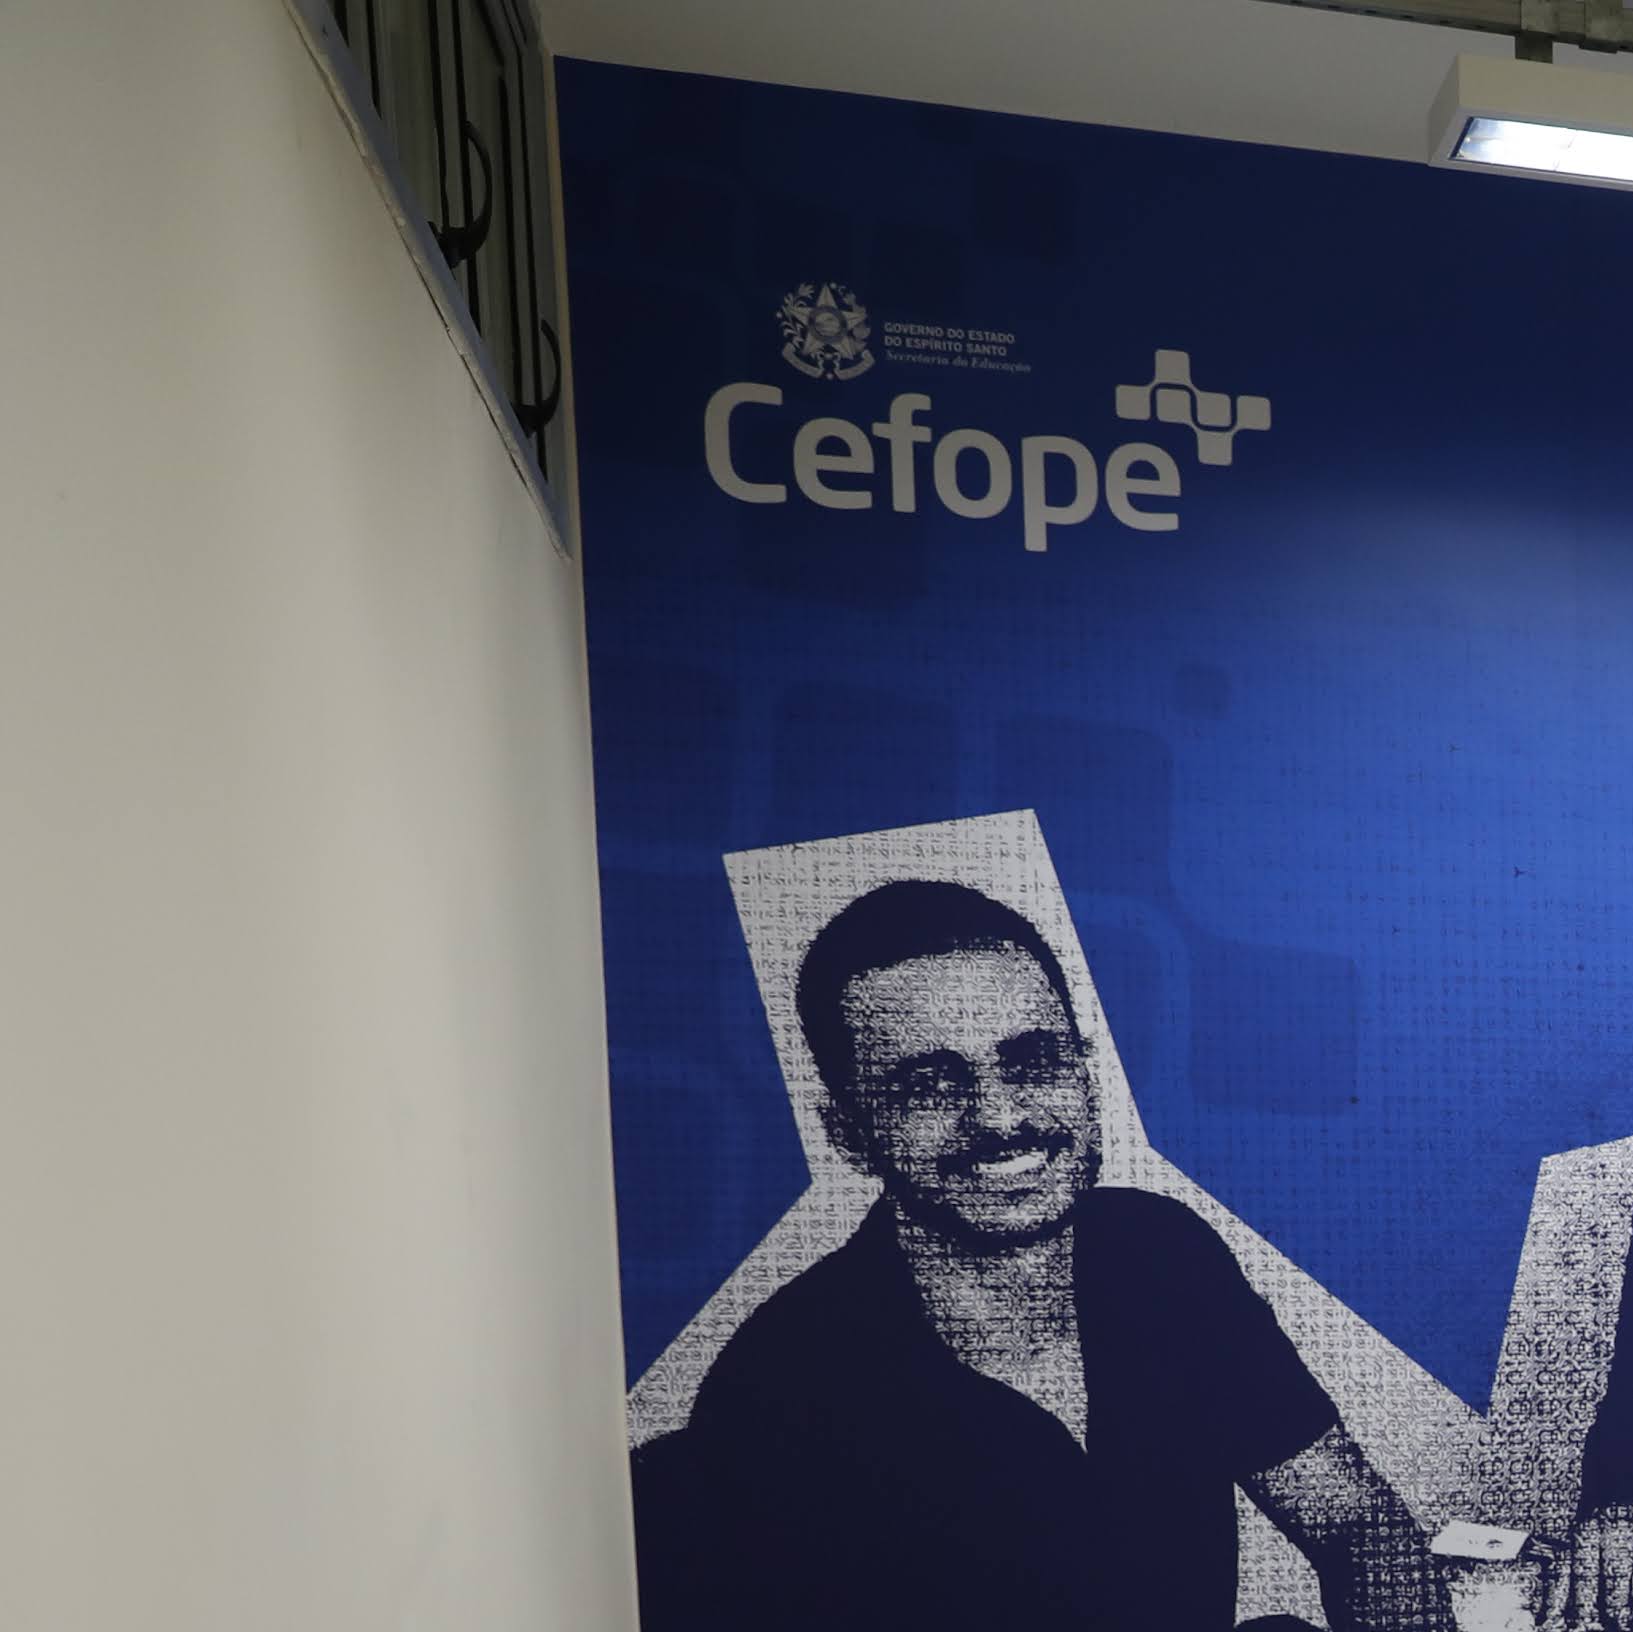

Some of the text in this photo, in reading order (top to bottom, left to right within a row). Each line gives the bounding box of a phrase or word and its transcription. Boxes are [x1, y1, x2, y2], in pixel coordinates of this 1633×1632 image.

[884, 322, 1016, 344] GOVERNO DO ESTADO
[884, 335, 1007, 356] DO ESPÍRITO SANTO
[704, 382, 1182, 552] Cefope
